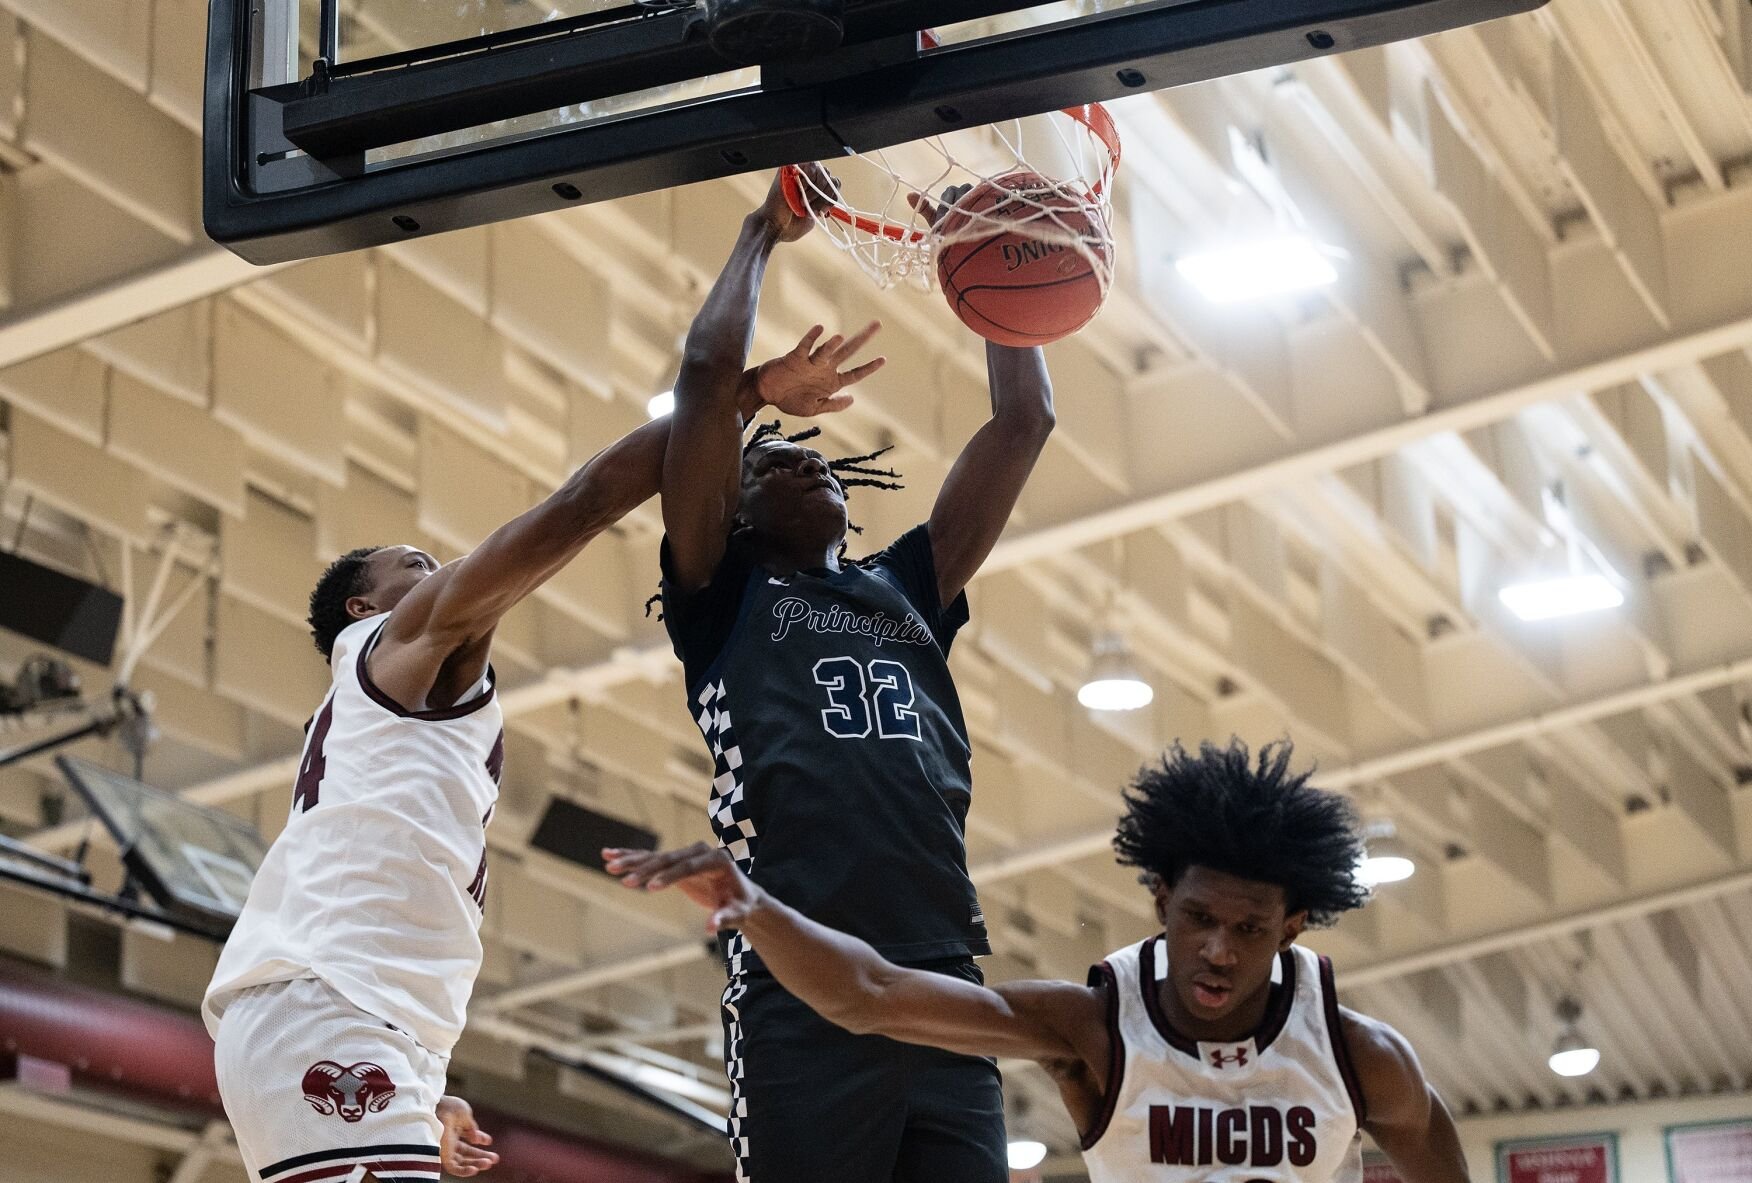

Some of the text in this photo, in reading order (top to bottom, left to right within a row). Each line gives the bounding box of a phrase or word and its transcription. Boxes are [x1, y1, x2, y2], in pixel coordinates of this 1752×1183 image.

[771, 596, 932, 647] Principia
[812, 655, 923, 742] 32
[1148, 1104, 1317, 1168] MICDS
